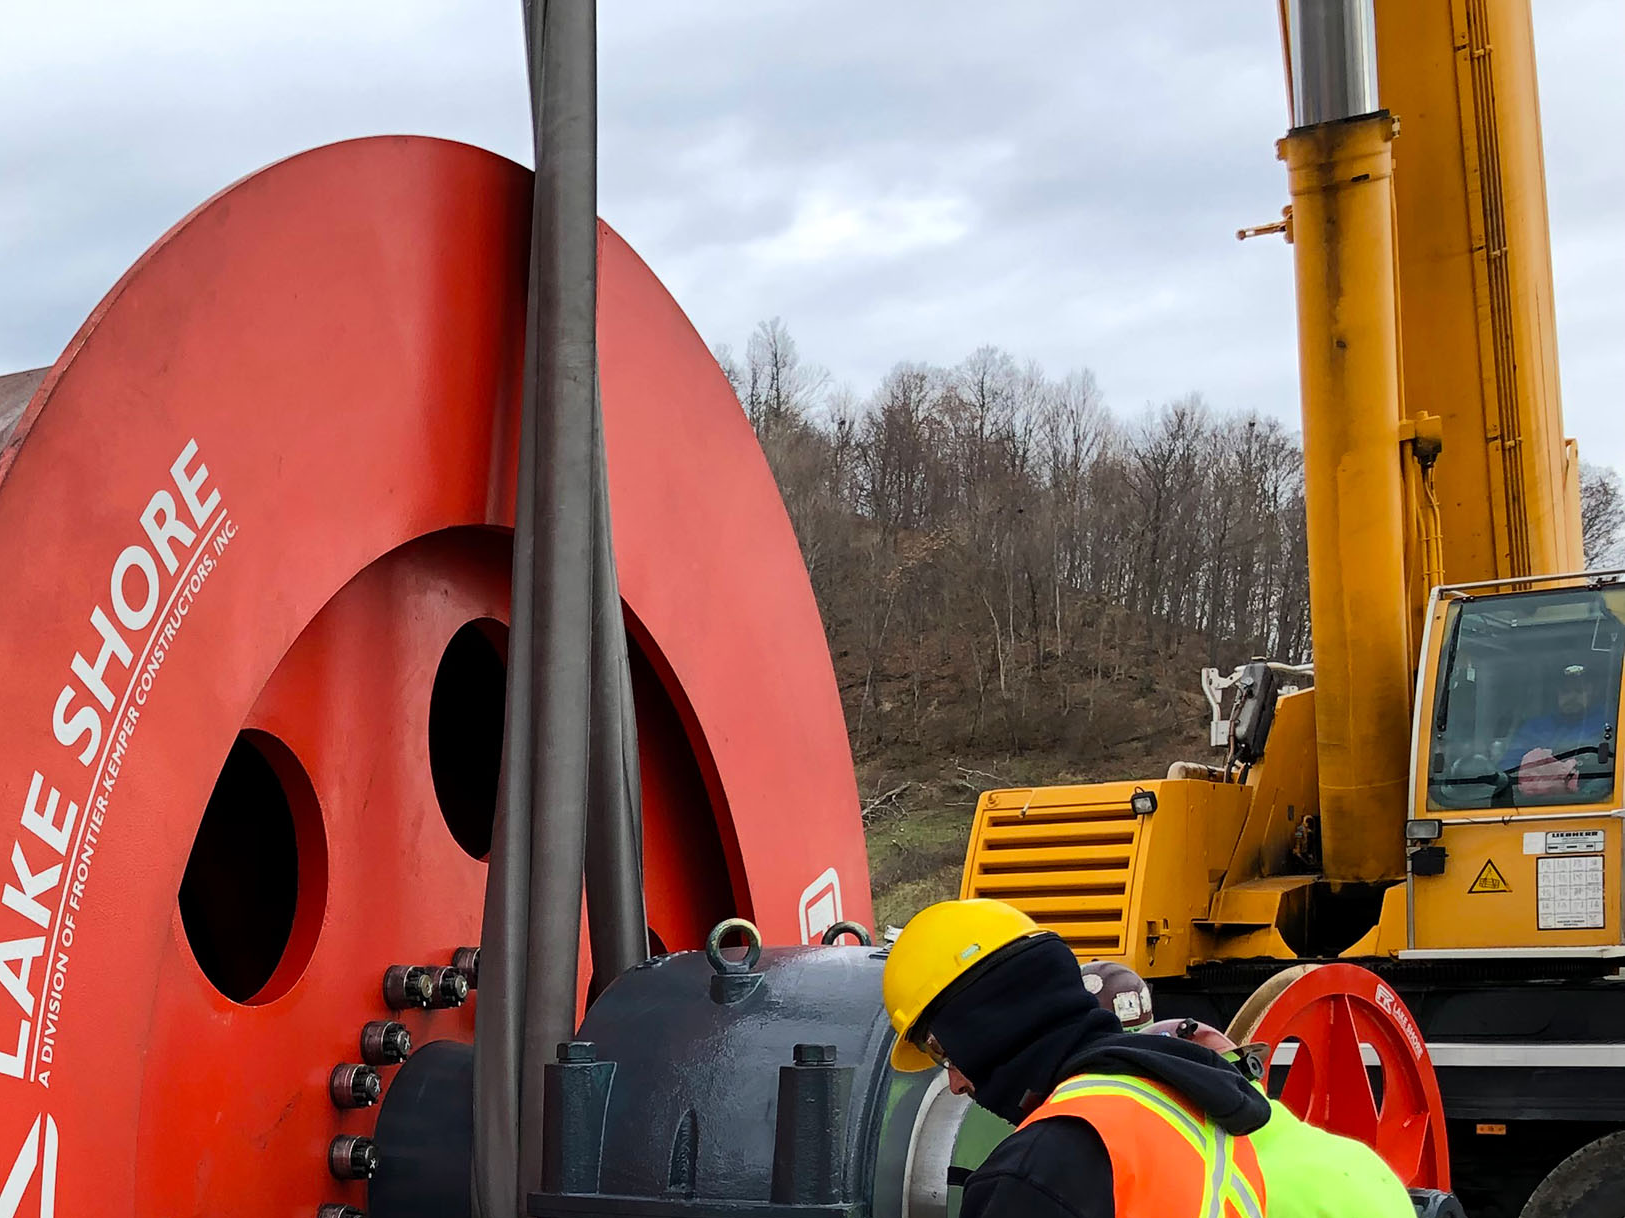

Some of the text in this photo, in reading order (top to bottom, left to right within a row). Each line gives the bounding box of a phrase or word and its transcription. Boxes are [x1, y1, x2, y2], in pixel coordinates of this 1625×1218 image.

[38, 519, 240, 1089] A DIVISION OF FRONTIER-KEMPER CONSTRUCTORS, INC.
[52, 437, 222, 768] SHORE
